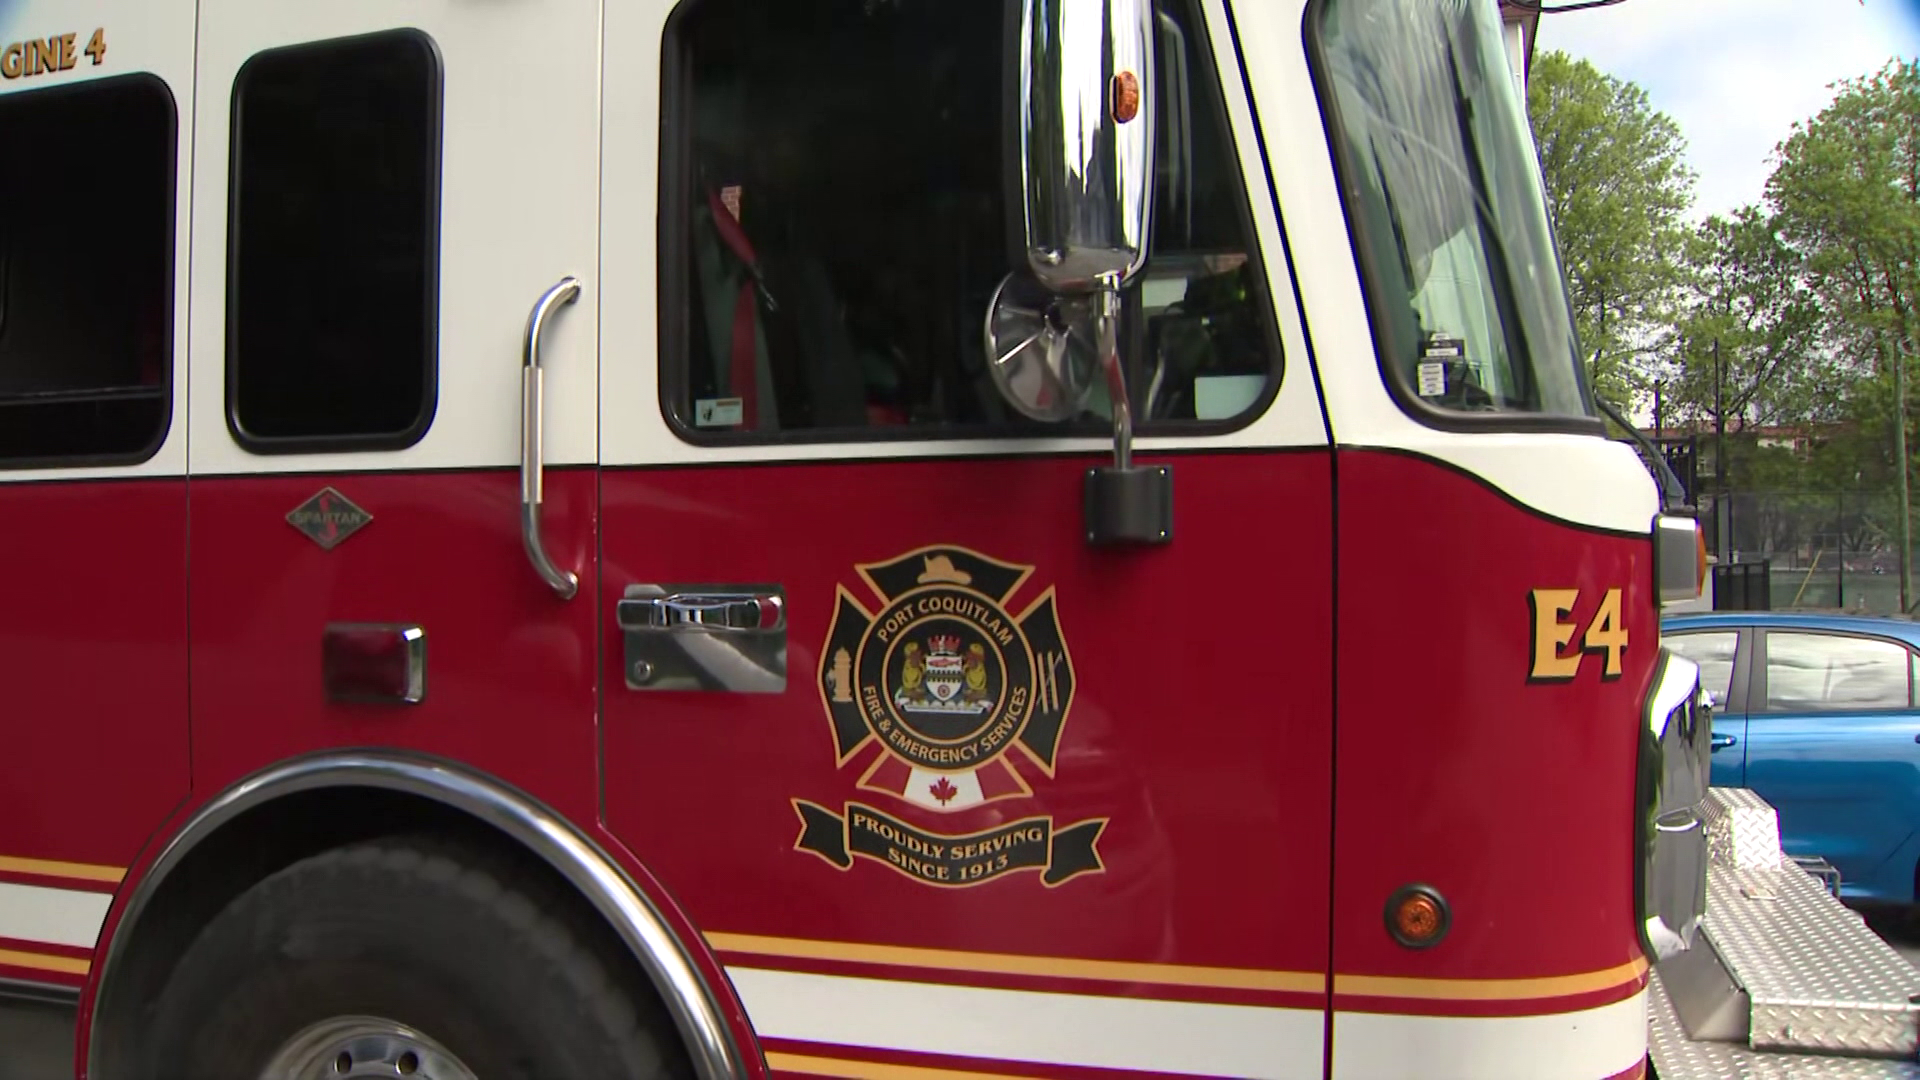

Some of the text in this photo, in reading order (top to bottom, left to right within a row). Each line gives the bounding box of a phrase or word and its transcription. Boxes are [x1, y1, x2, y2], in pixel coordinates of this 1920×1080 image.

[0, 27, 107, 79] GINE 4
[293, 511, 361, 525] SPARTAN
[878, 597, 1013, 645] PORT COQUITLAM
[1526, 587, 1629, 684] E4
[863, 684, 1027, 763] FIRE & EMERGENCY SERVICES
[853, 813, 1043, 861] PROUDLY SERVING
[888, 846, 1009, 880] SINCE 1913
